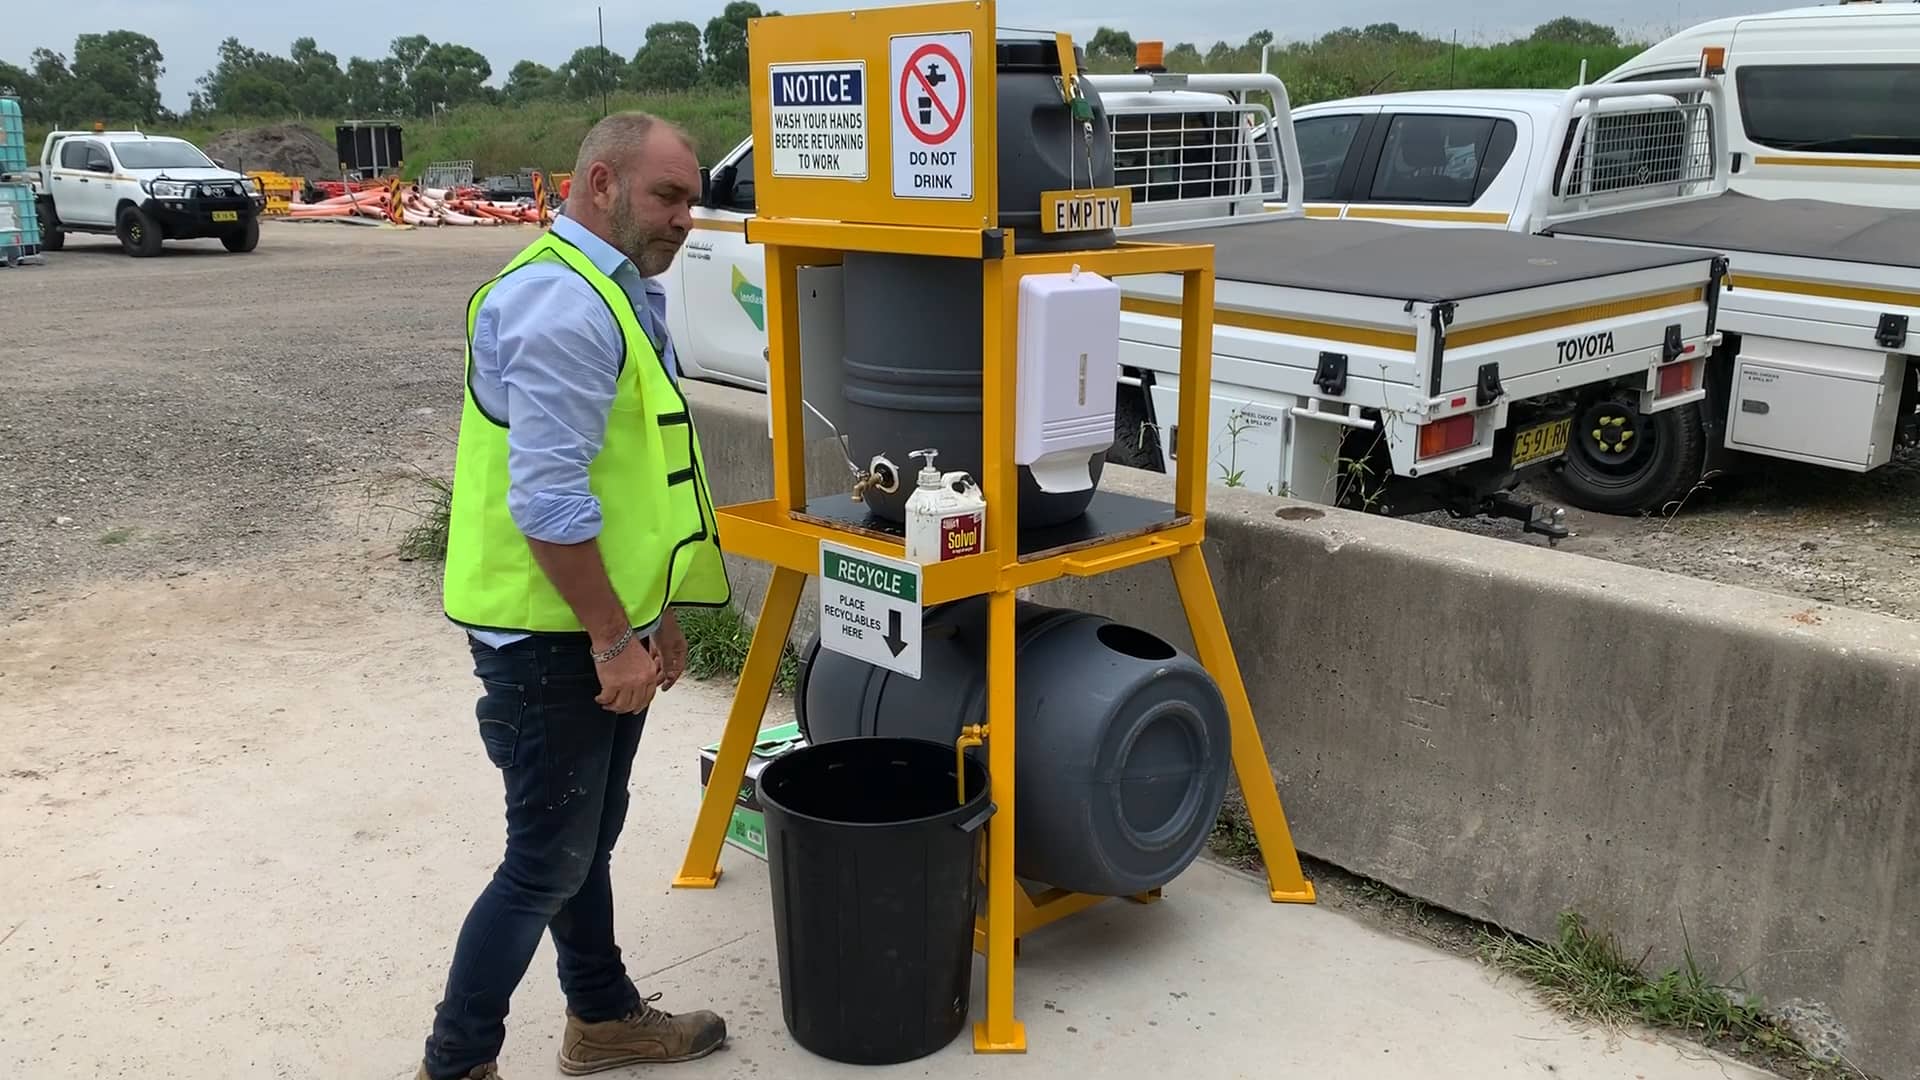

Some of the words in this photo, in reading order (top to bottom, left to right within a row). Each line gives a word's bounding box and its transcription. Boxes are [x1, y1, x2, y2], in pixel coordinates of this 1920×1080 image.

[782, 74, 852, 102] NOTICE
[774, 113, 801, 129] WASH
[803, 113, 827, 129] YOUR
[829, 113, 862, 129] HANDS
[775, 133, 809, 149] BEFORE
[811, 134, 863, 150] RETURNING
[798, 154, 810, 169] TO
[812, 154, 840, 170] WORK
[909, 151, 928, 166] DO
[931, 151, 957, 166] NOT
[914, 174, 953, 189] DRINK
[1057, 200, 1119, 229] EMPTY
[1557, 331, 1614, 364] TOYOTA
[948, 526, 977, 550] Solvol
[838, 559, 902, 594] RECYCLE
[840, 594, 865, 611] PLACE
[824, 604, 882, 631] RECYCLABLES
[842, 623, 864, 640] HERE
